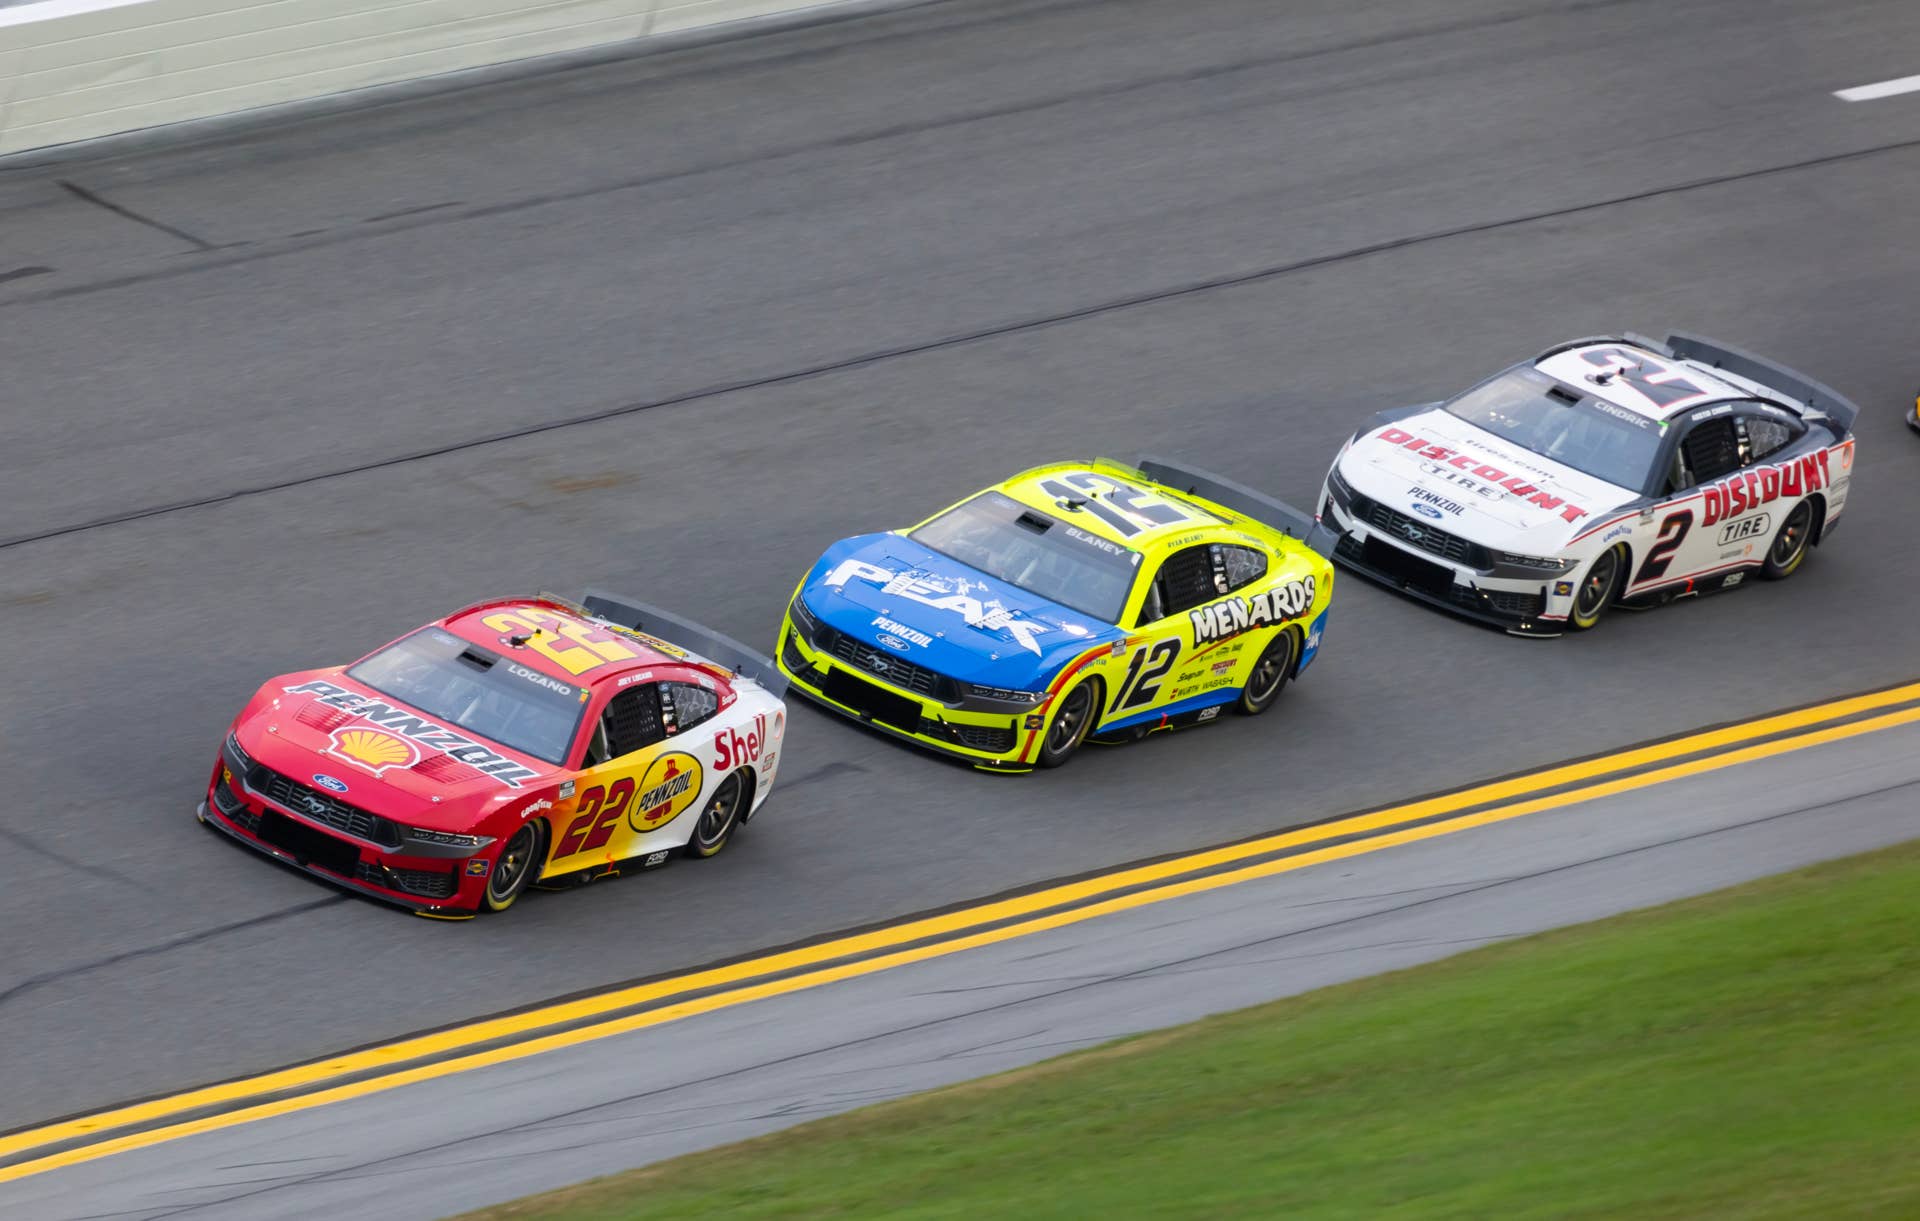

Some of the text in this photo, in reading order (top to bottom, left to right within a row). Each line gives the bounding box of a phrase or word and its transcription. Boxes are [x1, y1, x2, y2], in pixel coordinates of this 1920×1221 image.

[1580, 348, 1708, 409] 2
[1594, 399, 1650, 429] CINDRIC
[1038, 472, 1191, 540] 12
[1377, 428, 1589, 523] DISCOUNT
[1407, 486, 1465, 516] PENNZOIL
[1431, 464, 1496, 498] TIRE
[1701, 447, 1830, 527] DISCOUNT
[1064, 526, 1127, 557] BLANEY
[1632, 508, 1694, 586] 2
[1723, 516, 1763, 542] TIRE
[824, 559, 1050, 658] PEAK
[871, 616, 934, 648] PENNZOIL
[1190, 576, 1316, 650] MENARDS
[481, 607, 640, 675] 22
[507, 664, 571, 697] LOGANO
[1107, 635, 1183, 717] 12
[282, 680, 542, 788] PENNZOIL
[713, 713, 766, 771] Shell
[316, 775, 345, 791] Ford
[636, 768, 694, 816] PENNZOIL
[551, 776, 635, 862] 22
